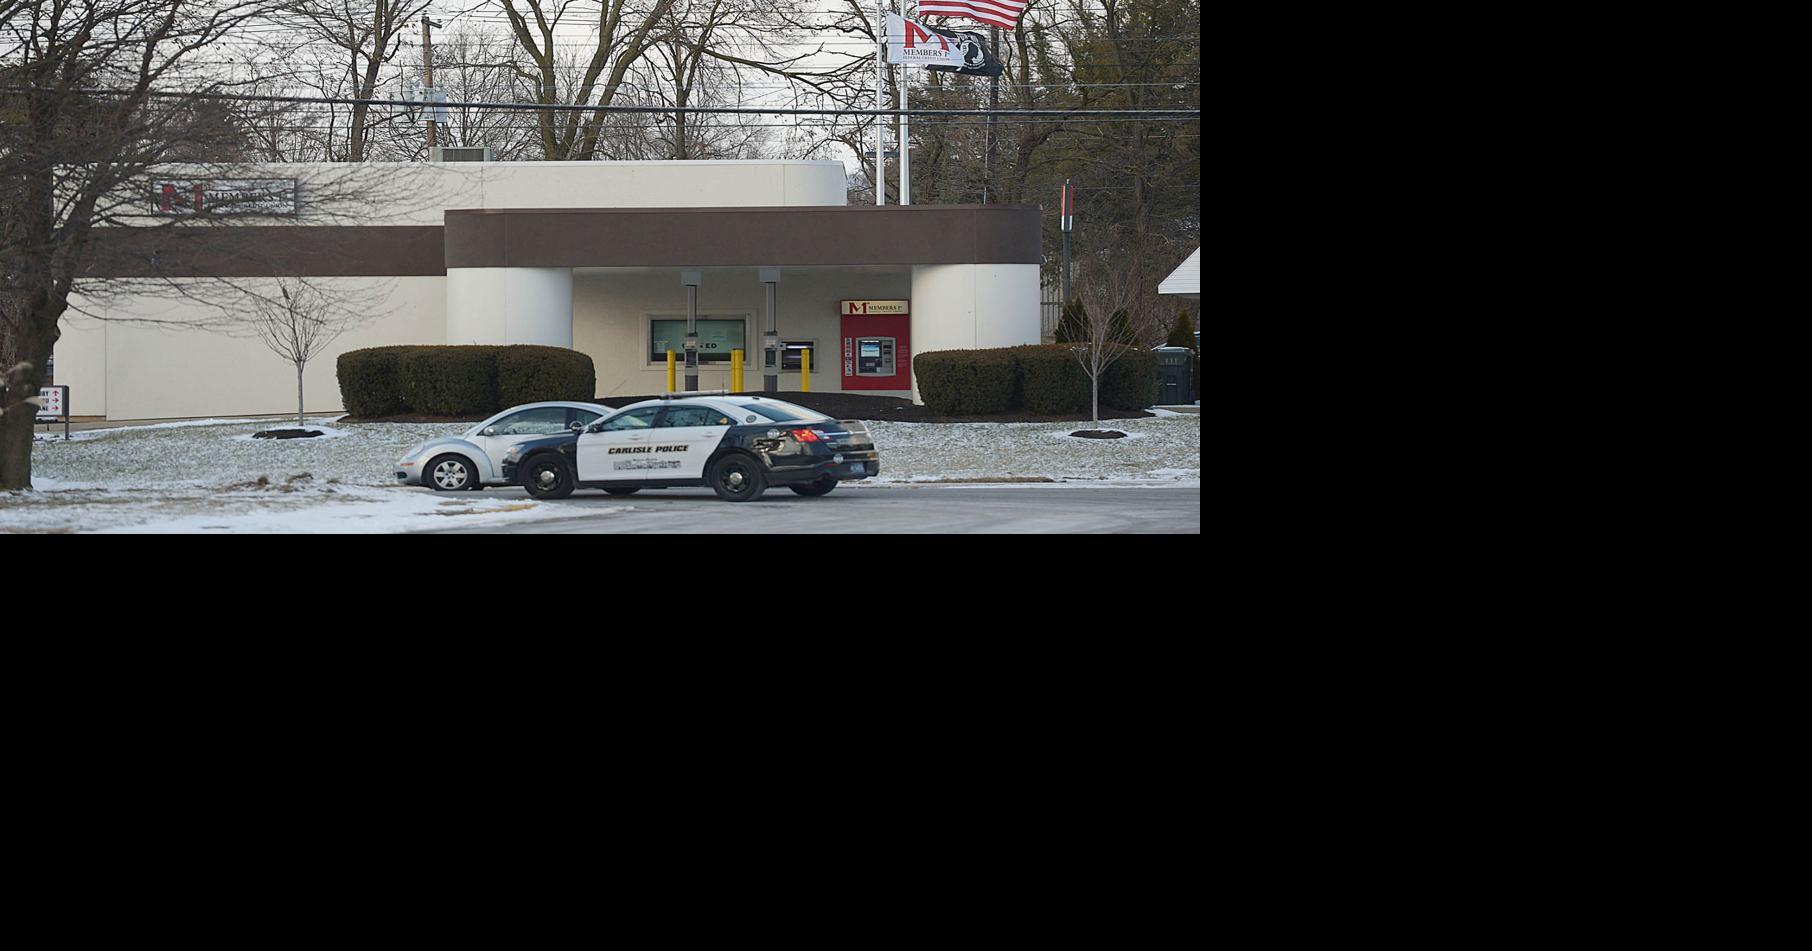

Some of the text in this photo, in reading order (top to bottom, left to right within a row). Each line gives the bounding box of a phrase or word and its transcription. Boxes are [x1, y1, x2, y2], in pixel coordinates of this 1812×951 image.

[903, 49, 942, 57] MEMBERS
[608, 444, 689, 455] CARLISLE POLICE
